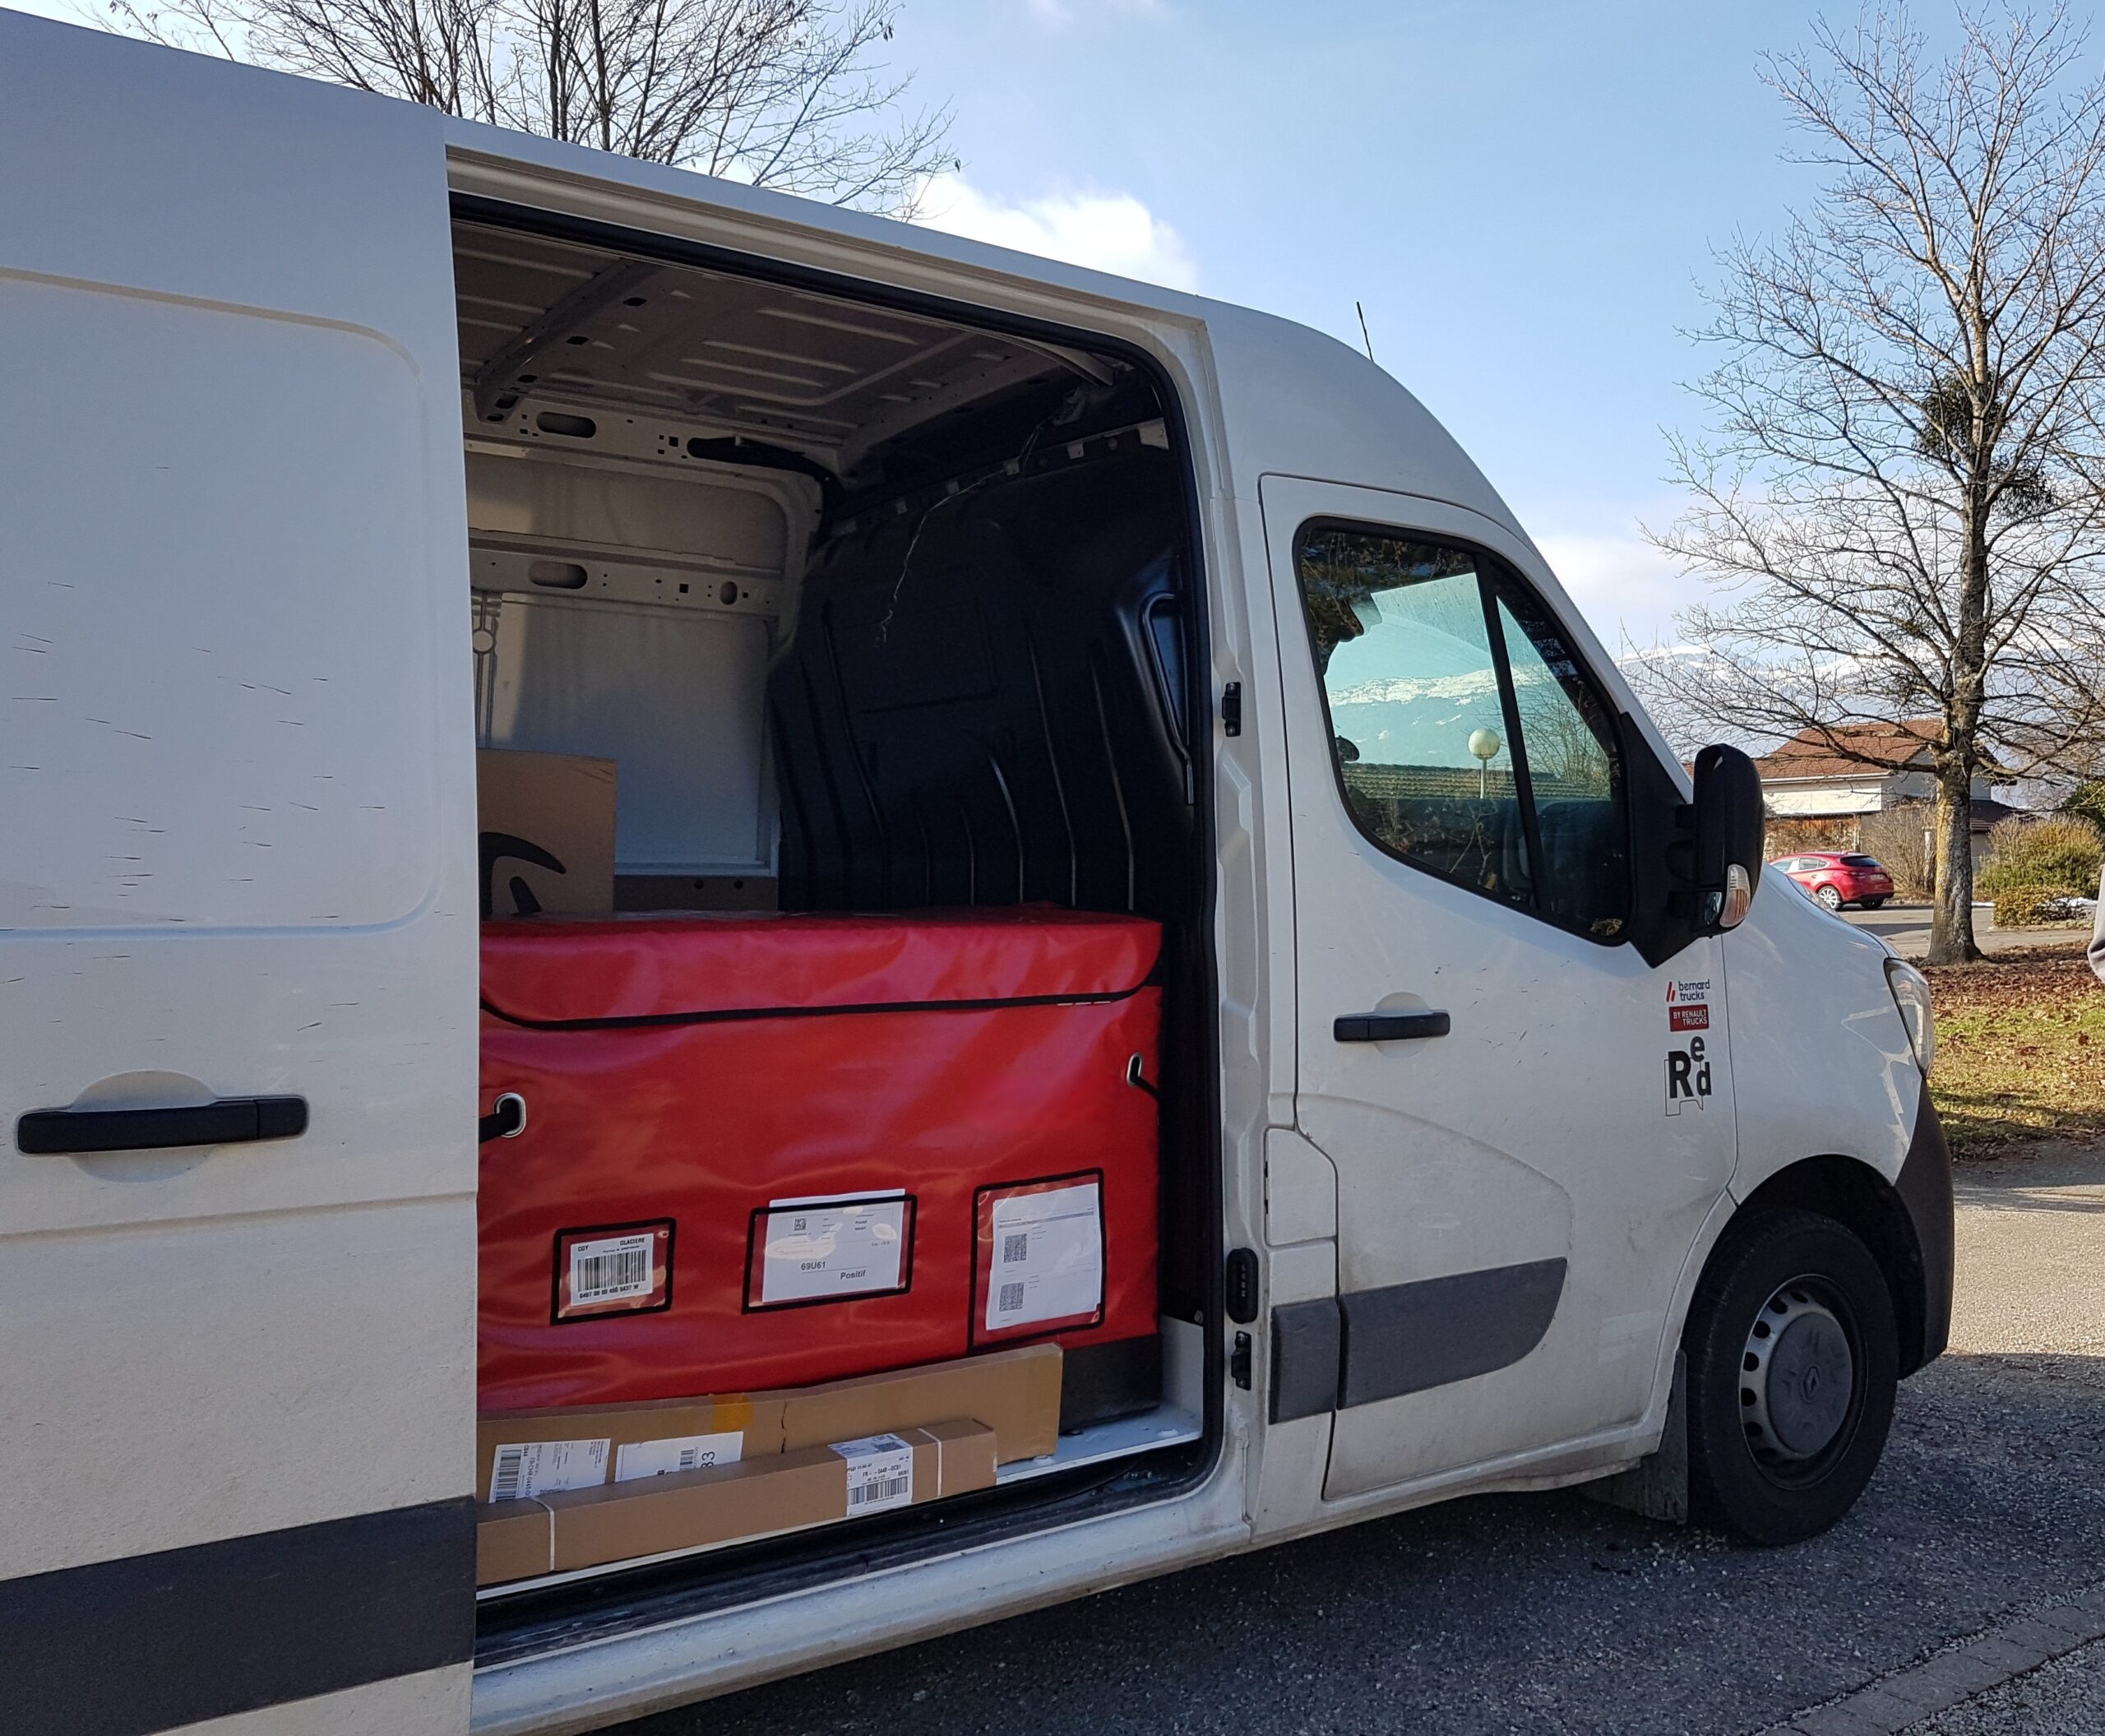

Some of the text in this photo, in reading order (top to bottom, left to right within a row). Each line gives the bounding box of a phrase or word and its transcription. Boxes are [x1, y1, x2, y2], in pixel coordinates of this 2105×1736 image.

[1678, 979, 1709, 991] bernard
[1680, 991, 1705, 1001] trucks
[1682, 1009, 1707, 1019] RENAULT
[1682, 1017, 1708, 1025] TRUCKS
[620, 1238, 645, 1246] GLACIERE
[801, 1261, 826, 1271] 69U61
[840, 1270, 866, 1280] Positif
